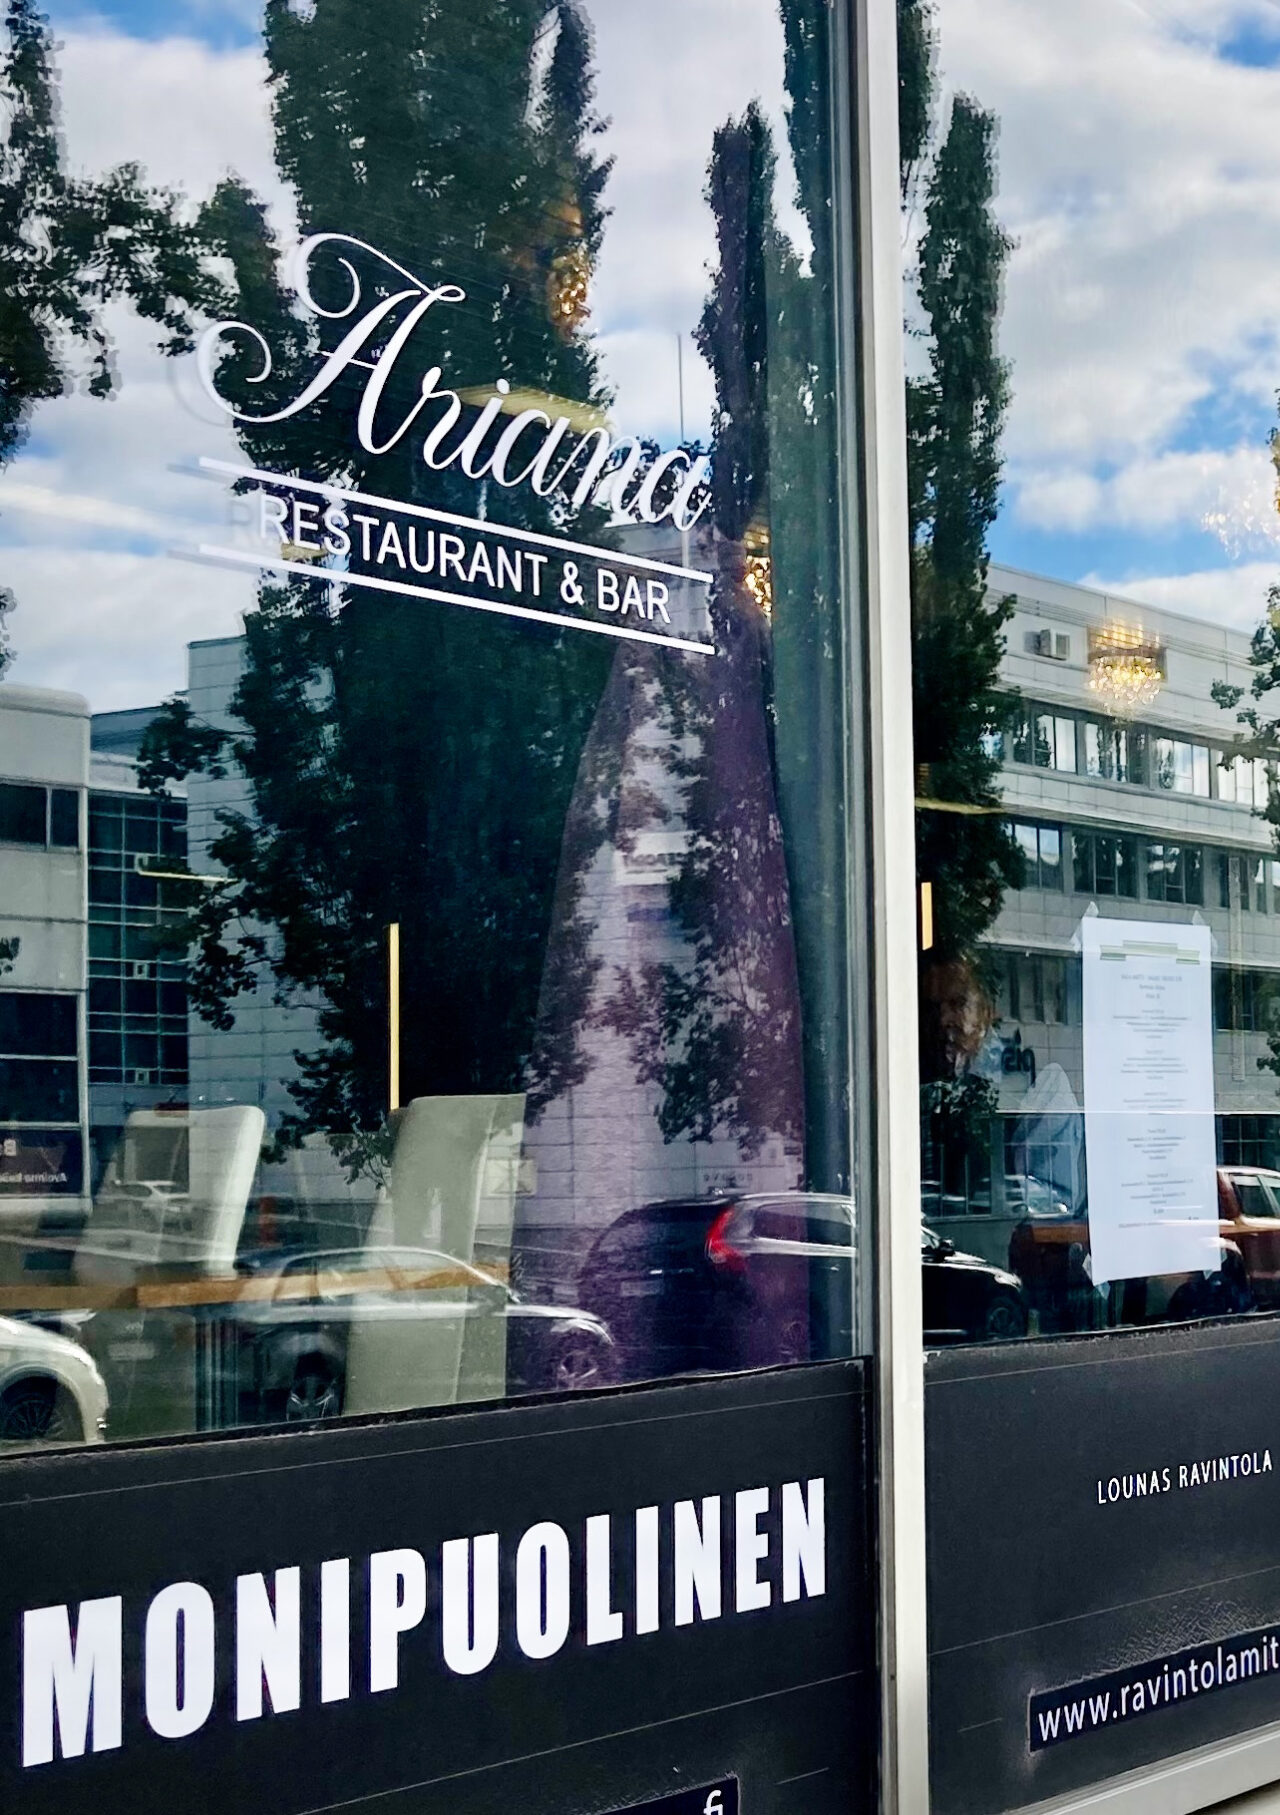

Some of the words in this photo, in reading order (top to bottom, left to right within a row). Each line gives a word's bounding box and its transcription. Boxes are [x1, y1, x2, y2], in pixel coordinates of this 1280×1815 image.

[198, 232, 714, 531] Ariana
[259, 494, 547, 596] RESTAURANT
[560, 562, 585, 605] &
[597, 568, 670, 624] BAR
[1098, 1468, 1171, 1504] LOUNAS
[1179, 1450, 1273, 1488] RAVINTOLA
[22, 1477, 826, 1768] MONIPUOLINEN
